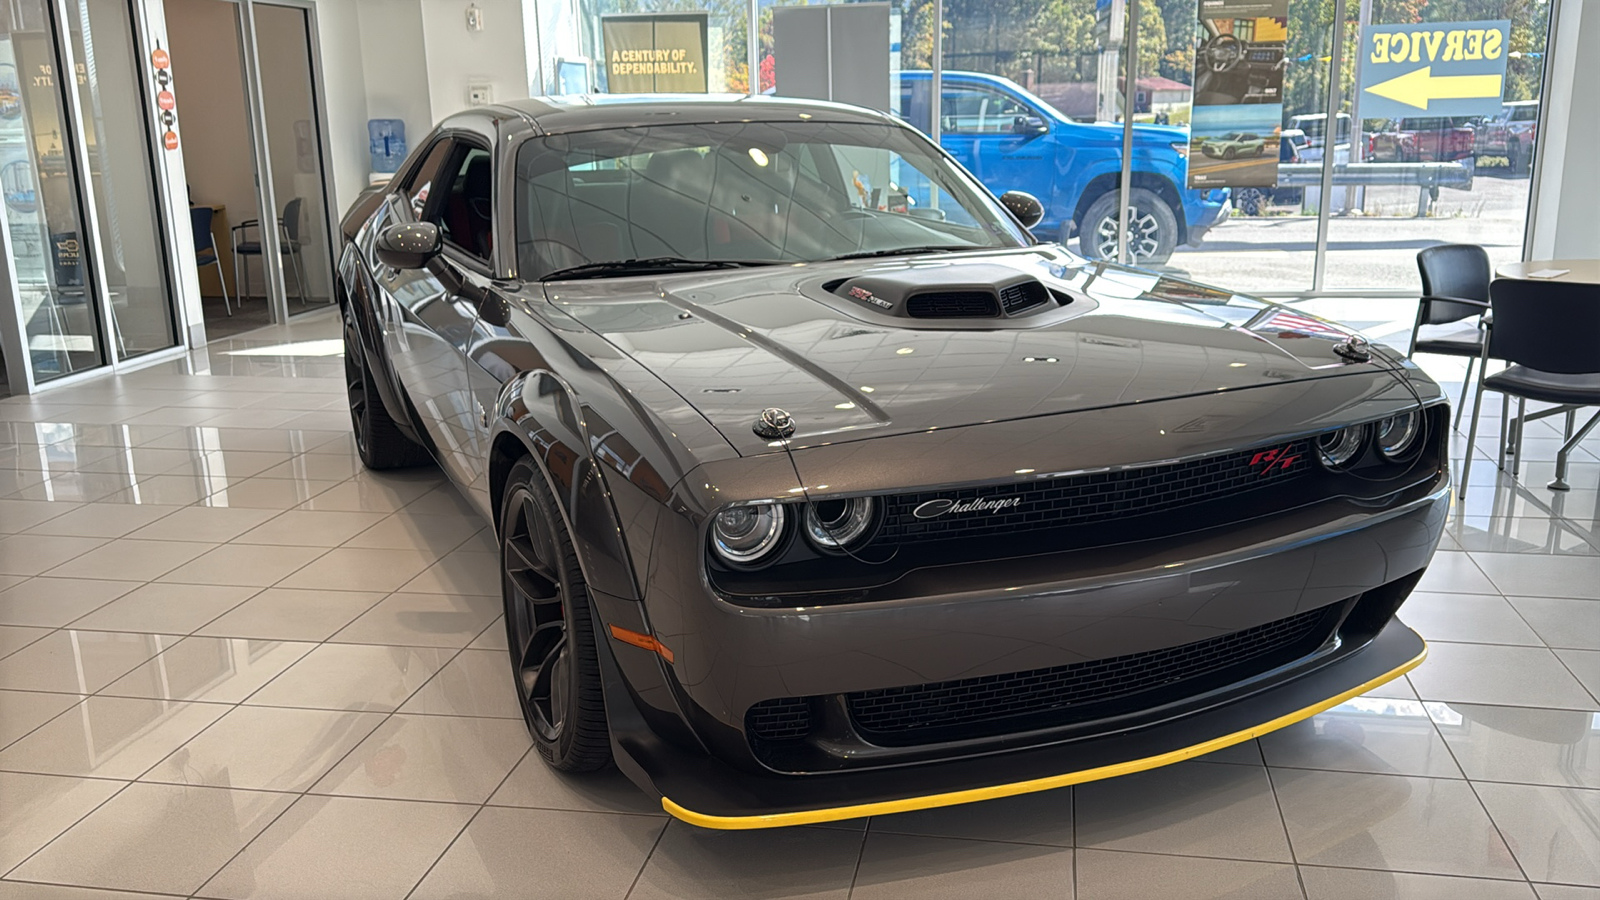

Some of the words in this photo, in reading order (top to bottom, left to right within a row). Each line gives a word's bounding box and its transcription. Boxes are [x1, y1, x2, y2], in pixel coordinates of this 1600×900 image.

[612, 50, 620, 62] A
[621, 49, 670, 62] CENTURY
[671, 49, 686, 61] OF
[612, 62, 697, 75] DEPENDABILITY.
[1249, 444, 1301, 475] R/T
[913, 498, 1020, 518] Challenger
